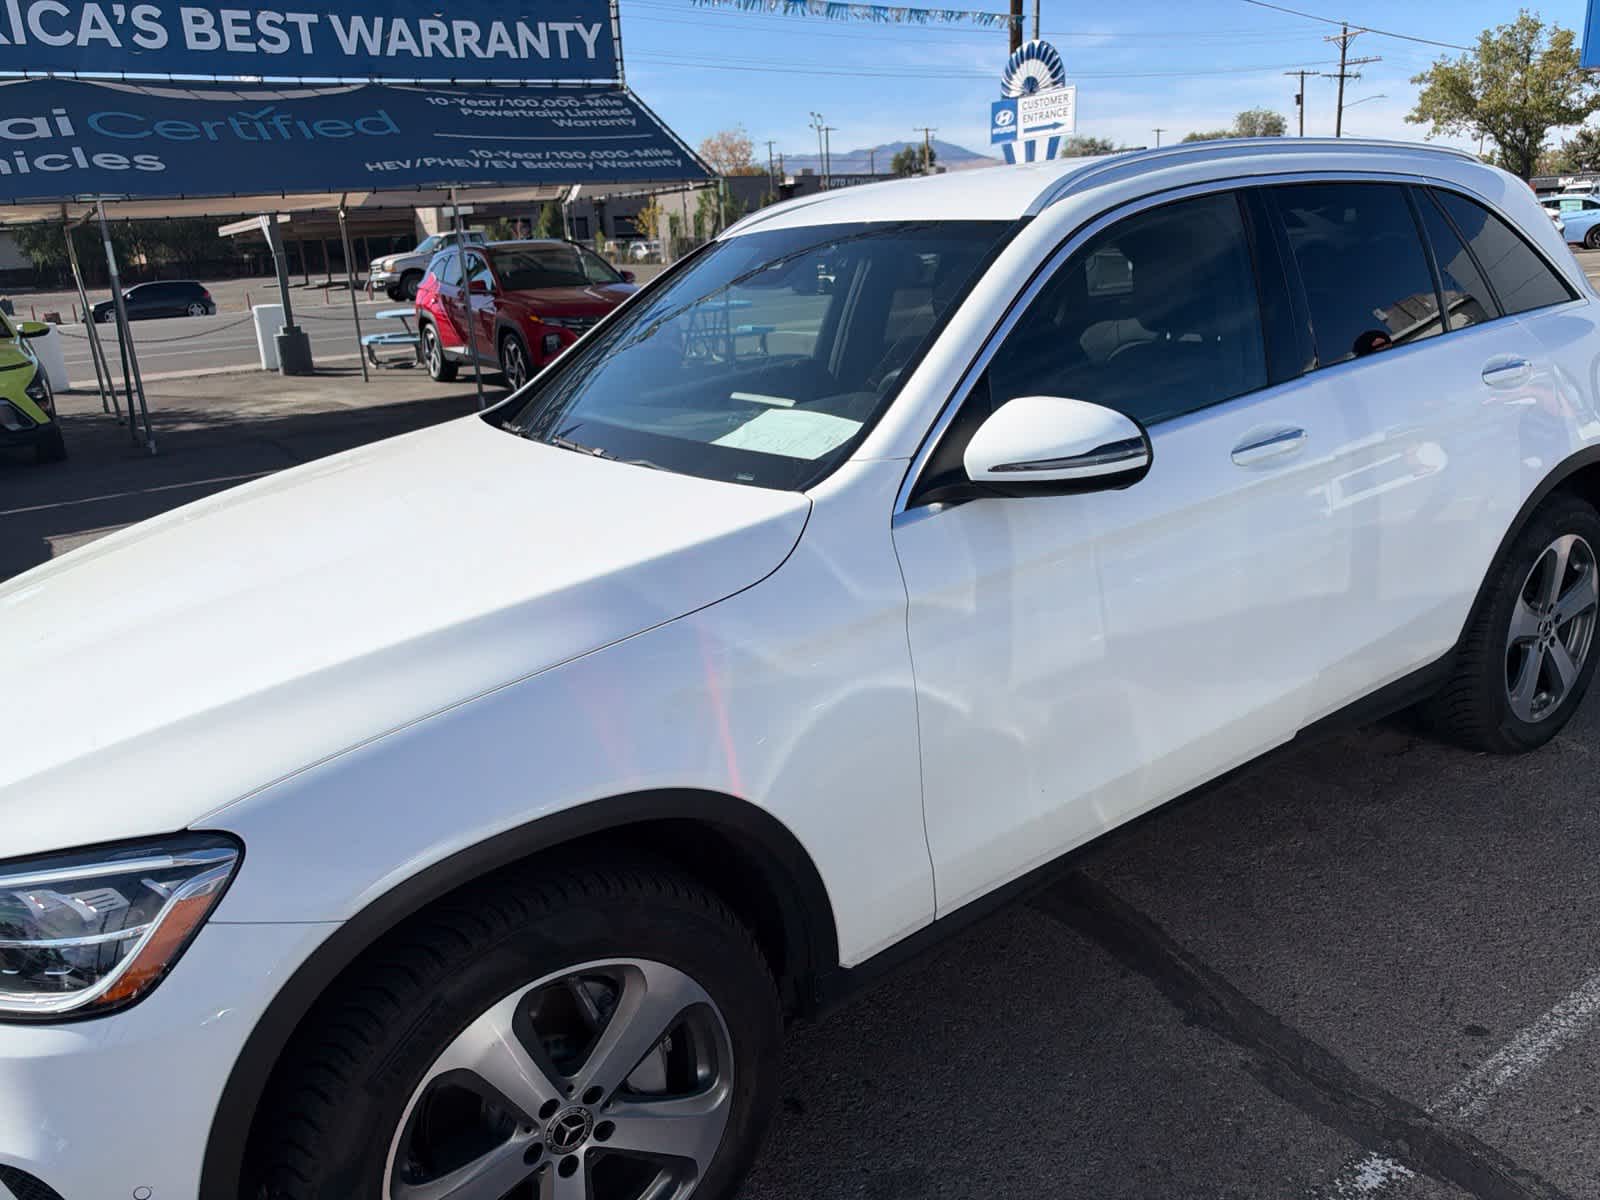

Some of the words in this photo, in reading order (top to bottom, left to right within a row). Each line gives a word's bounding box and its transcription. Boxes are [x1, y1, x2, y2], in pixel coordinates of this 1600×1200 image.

[0, 0, 169, 50] ICA'S
[180, 7, 318, 54] BEST
[328, 15, 602, 59] WARRANTY
[1022, 94, 1070, 110] CUSTOMER
[460, 107, 564, 117] Powertrain
[567, 107, 633, 116] Limited
[1022, 107, 1069, 123] ENTRANCE
[87, 106, 400, 141] Certified
[552, 118, 637, 127] Warranty
[522, 160, 593, 169] Battery
[595, 158, 681, 168] Warranty
